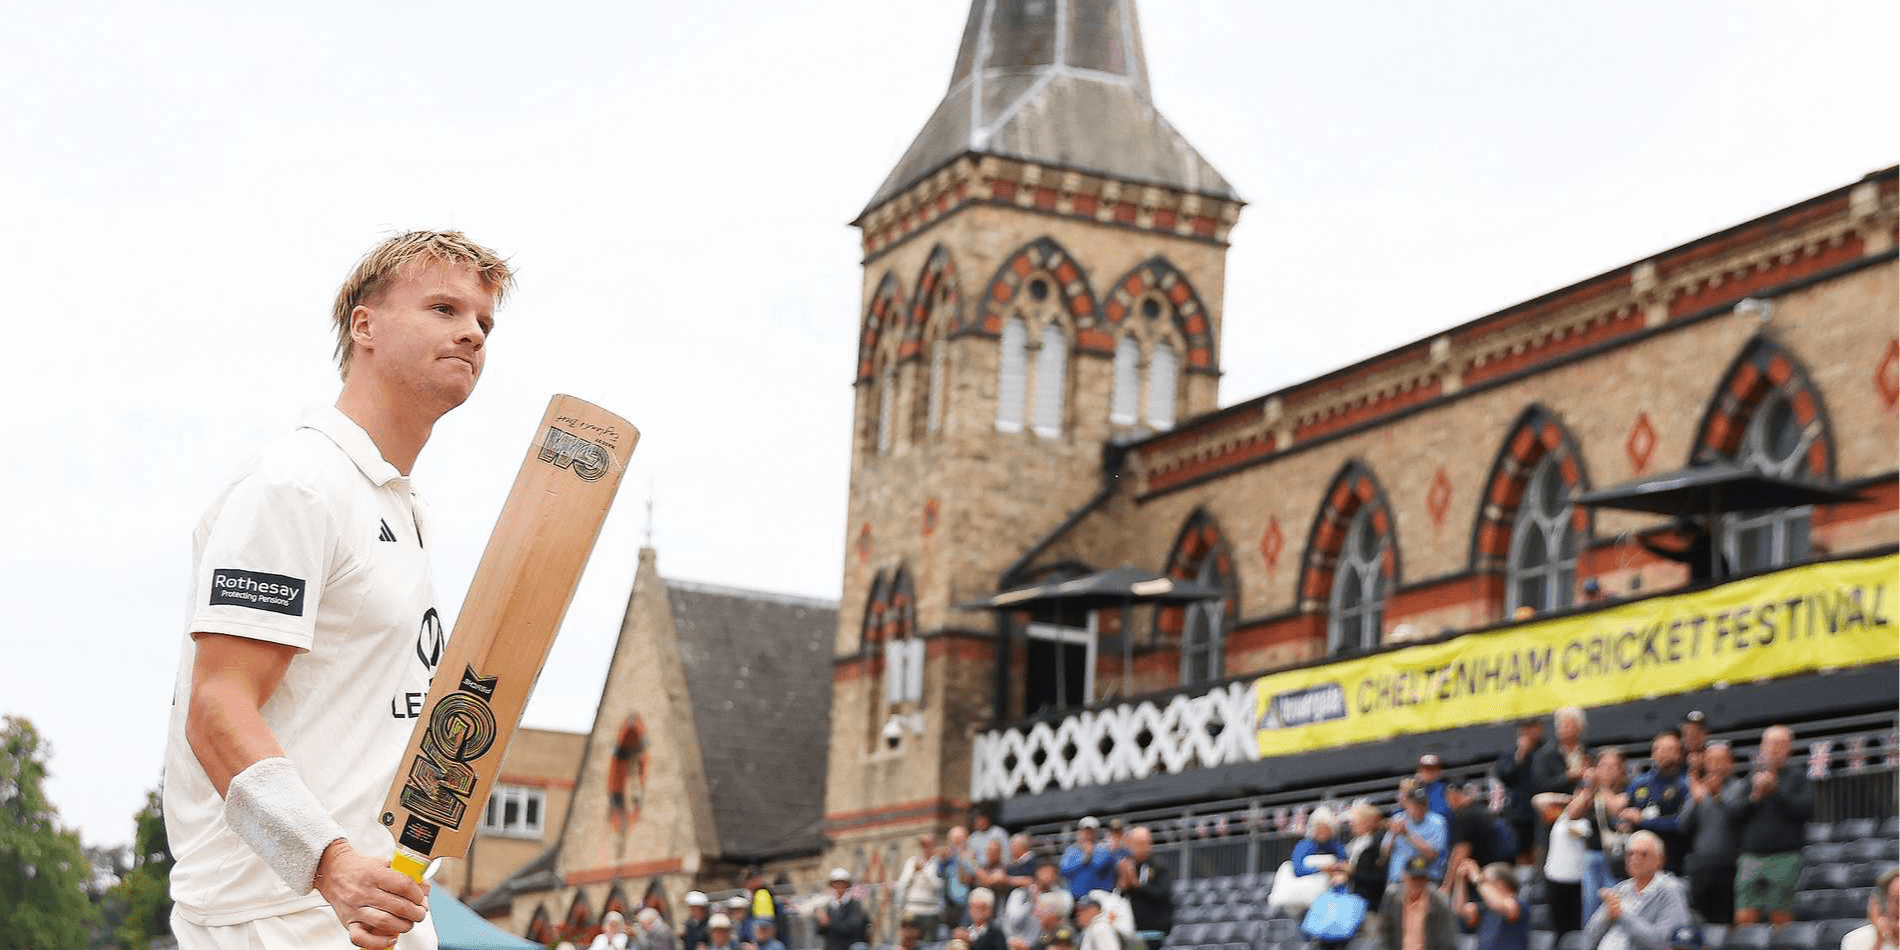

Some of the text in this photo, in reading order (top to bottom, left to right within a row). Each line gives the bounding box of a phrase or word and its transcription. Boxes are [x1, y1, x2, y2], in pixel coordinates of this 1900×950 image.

[215, 575, 299, 600] Rothesay
[221, 590, 289, 606] Protecting Pensions
[1356, 643, 1552, 714] CHELTENHAM
[1562, 615, 1706, 680] CRICKET
[1713, 583, 1888, 655] FESTIVAL
[391, 692, 427, 718] LE
